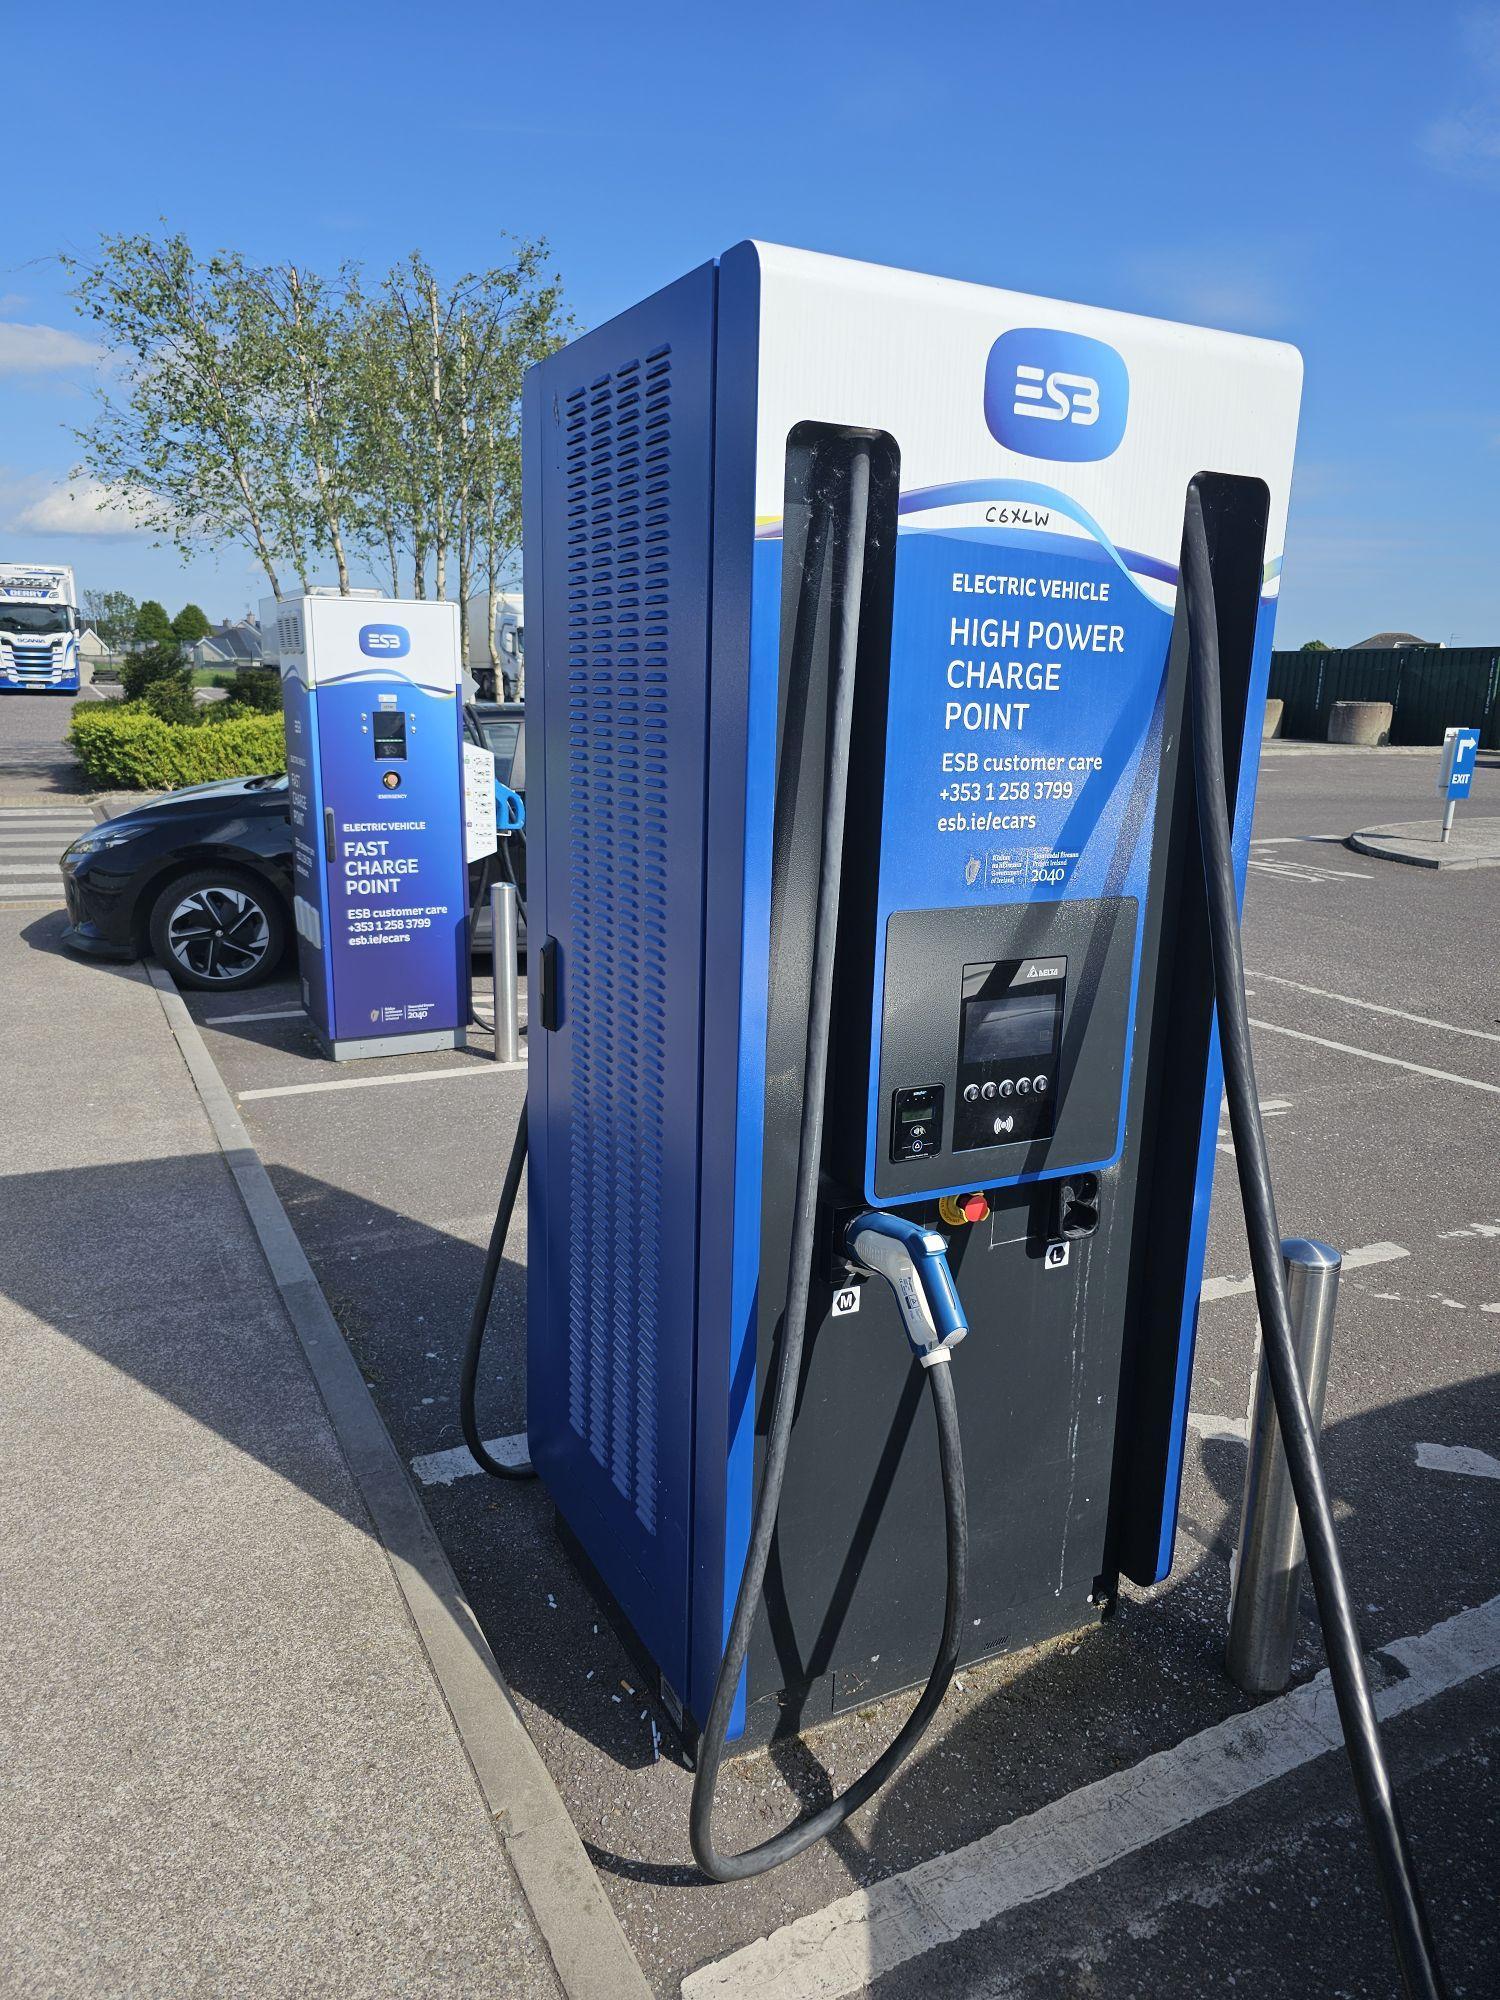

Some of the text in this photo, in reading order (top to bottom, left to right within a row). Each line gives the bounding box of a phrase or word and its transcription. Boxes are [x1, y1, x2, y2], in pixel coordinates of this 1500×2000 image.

[1013, 365, 1099, 426] ESB
[985, 507, 1050, 527] C6XLW
[952, 573, 1110, 602] ELECTRIC VEHICLE
[368, 633, 401, 649] ESB
[949, 617, 1125, 653] HIGH POWER
[947, 660, 1062, 691] CHARGE
[945, 702, 1030, 731] POINT
[942, 752, 1102, 772] ESB customer care
[1451, 774, 1470, 785] EXIT
[939, 781, 1073, 802] +353 1 258 3799
[343, 821, 426, 833] ELECTRIC VEHICLE
[937, 811, 1036, 832] esb.ie/ecars
[344, 841, 389, 857] FAST
[345, 858, 419, 876] CHARGE
[1031, 868, 1065, 885] 2040
[346, 878, 401, 895] POINT
[348, 904, 448, 920] ESB customer care
[348, 918, 431, 932] +353 1 258 3799
[348, 932, 411, 946] esb.ie/ecars
[1038, 968, 1059, 977] DELTA
[408, 1010, 428, 1019] 2040
[1053, 1251, 1062, 1262] L
[839, 1293, 853, 1309] M
